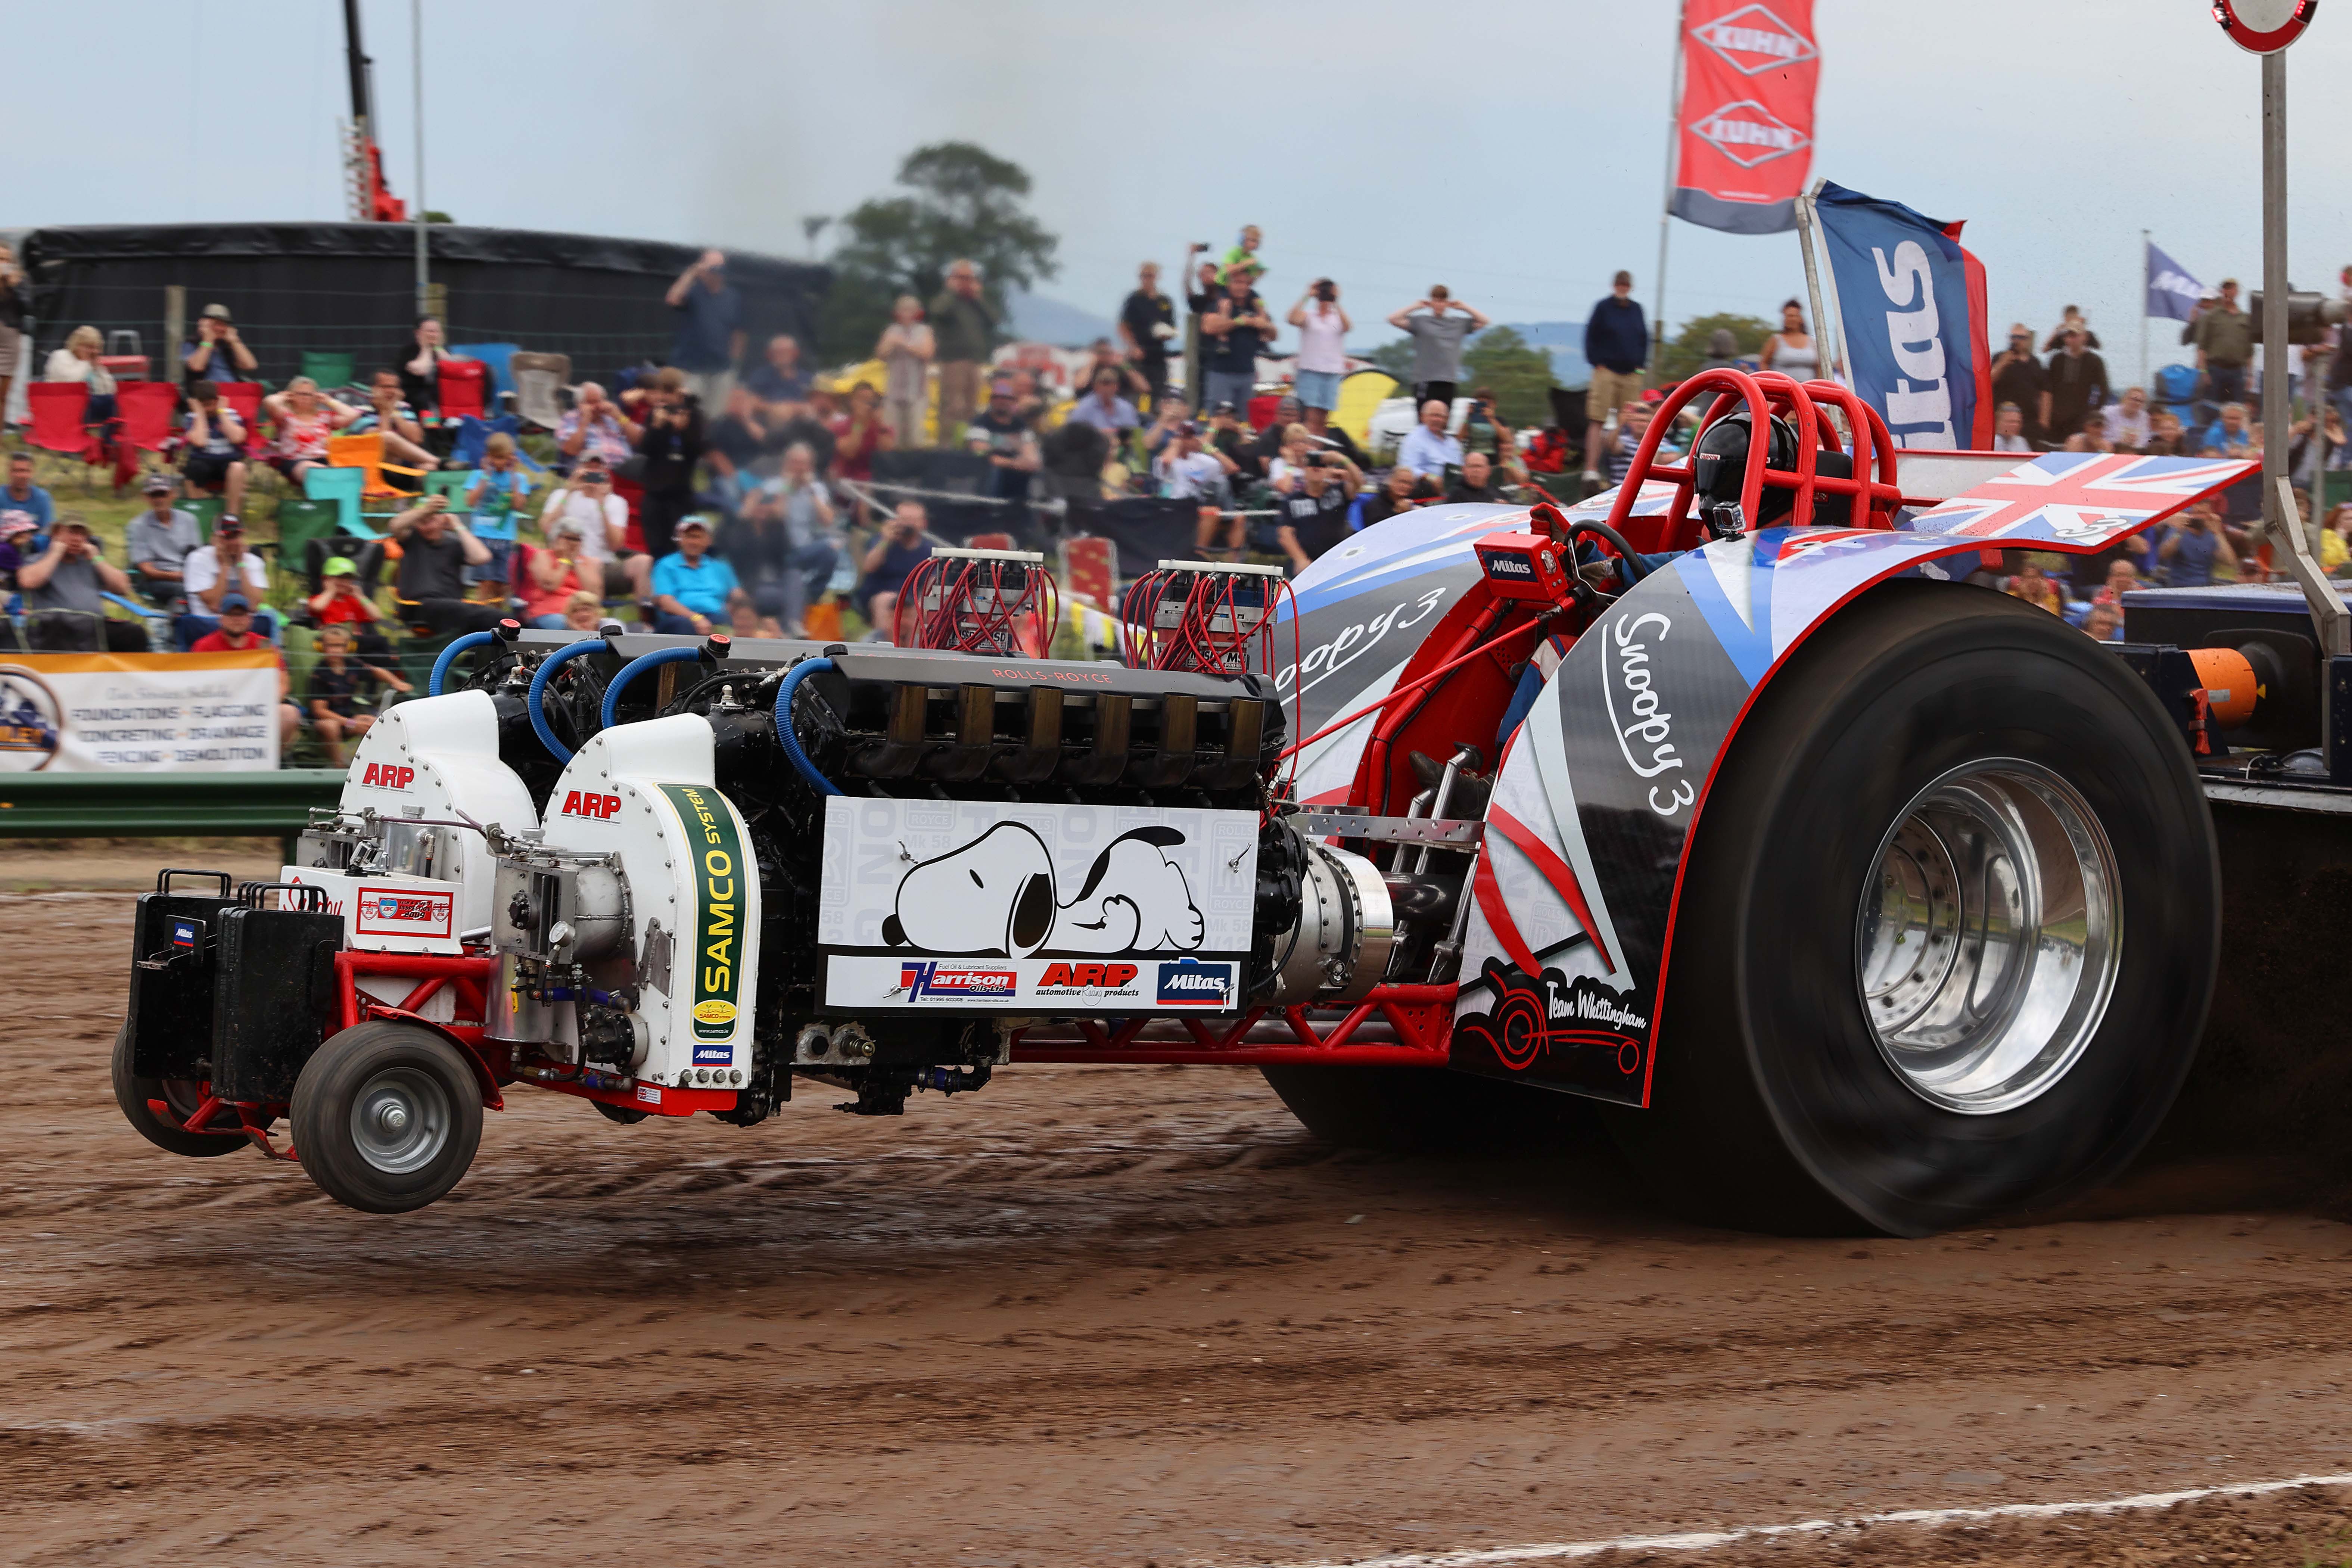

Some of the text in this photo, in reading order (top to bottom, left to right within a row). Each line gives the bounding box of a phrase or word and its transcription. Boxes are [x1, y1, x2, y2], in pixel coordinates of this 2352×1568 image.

[1714, 25, 1797, 58] KUHN
[1712, 119, 1793, 149] KUHN
[1871, 240, 1957, 449] itas
[1492, 560, 1531, 574] Mitas
[992, 669, 1113, 684] ROLLS-ROYCE
[1602, 612, 1695, 816] Snoopy 3
[362, 763, 414, 789] ARP
[562, 790, 621, 819] ARP
[681, 788, 721, 844] SYSTEM
[911, 814, 948, 825] ROYCE
[1218, 825, 1254, 836] ROLLS
[1214, 899, 1250, 909] ROYCE
[704, 850, 734, 993] SAMCO
[902, 961, 1009, 1002] Harrison
[1037, 962, 1139, 987] ARP
[1164, 974, 1225, 990] Mitas
[1104, 988, 1139, 997] products
[1546, 981, 1647, 1031] Team Whittingham
[696, 1050, 730, 1059] Mitas
